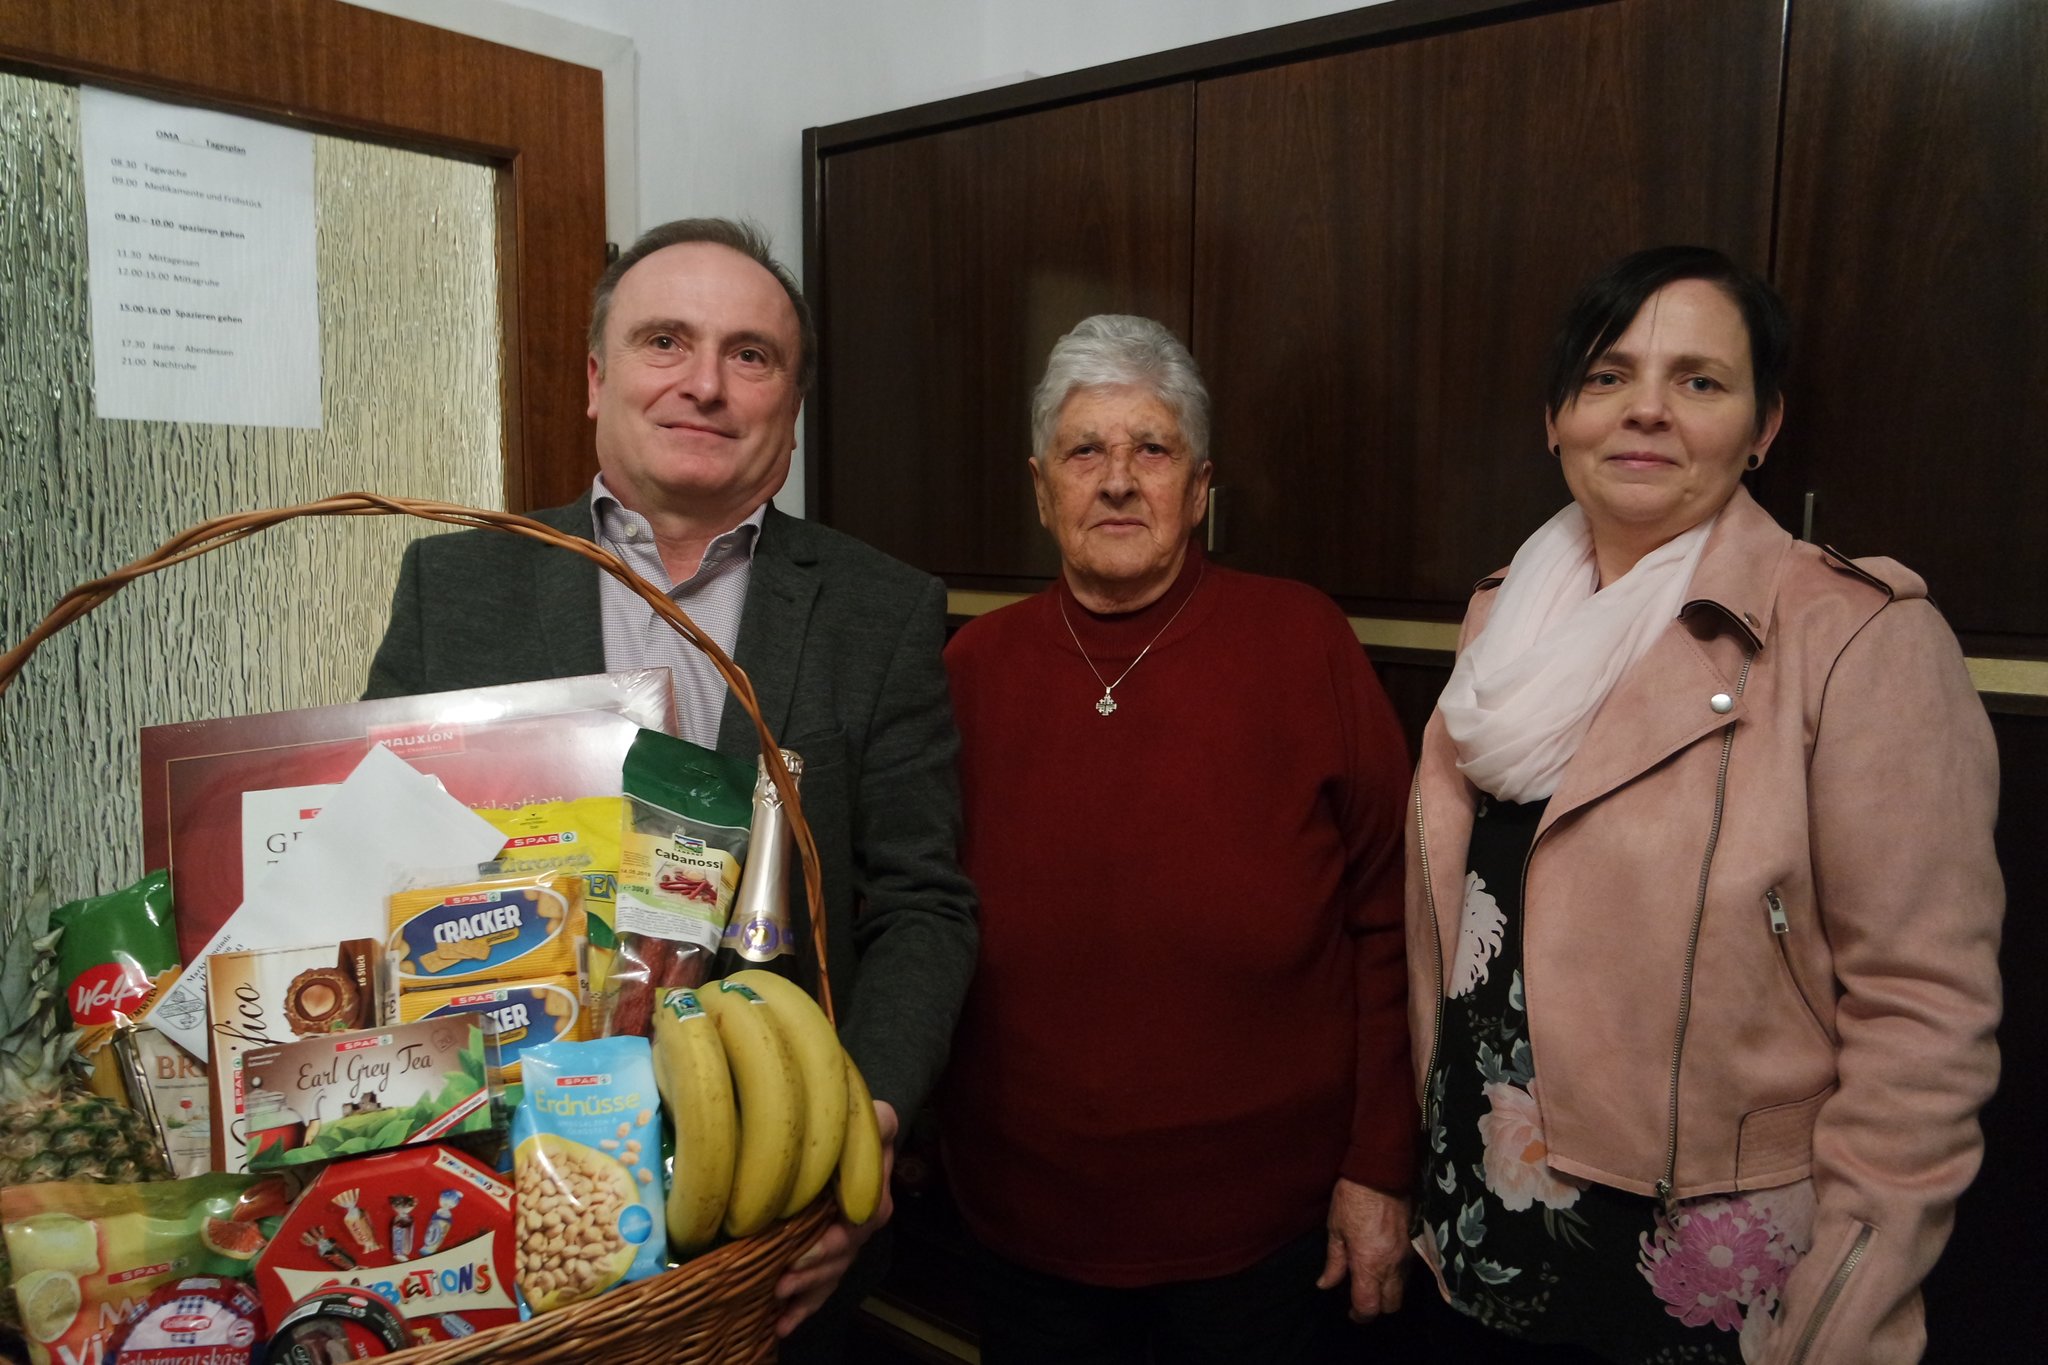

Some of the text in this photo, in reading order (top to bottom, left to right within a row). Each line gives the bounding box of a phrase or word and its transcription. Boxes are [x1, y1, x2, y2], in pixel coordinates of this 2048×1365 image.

[155, 130, 180, 142] OMA
[513, 834, 560, 847] SPAR
[655, 848, 723, 870] Cabanossi
[452, 894, 487, 904] SPAR
[433, 904, 522, 943] CRACKER
[76, 972, 142, 1016] Wolf
[344, 1038, 379, 1050] SPAR
[297, 1057, 338, 1091] Earl
[347, 1053, 391, 1098] Grey
[397, 1043, 433, 1074] Tea
[564, 1076, 599, 1085] SPAR
[535, 1090, 641, 1116] Erdnüsse
